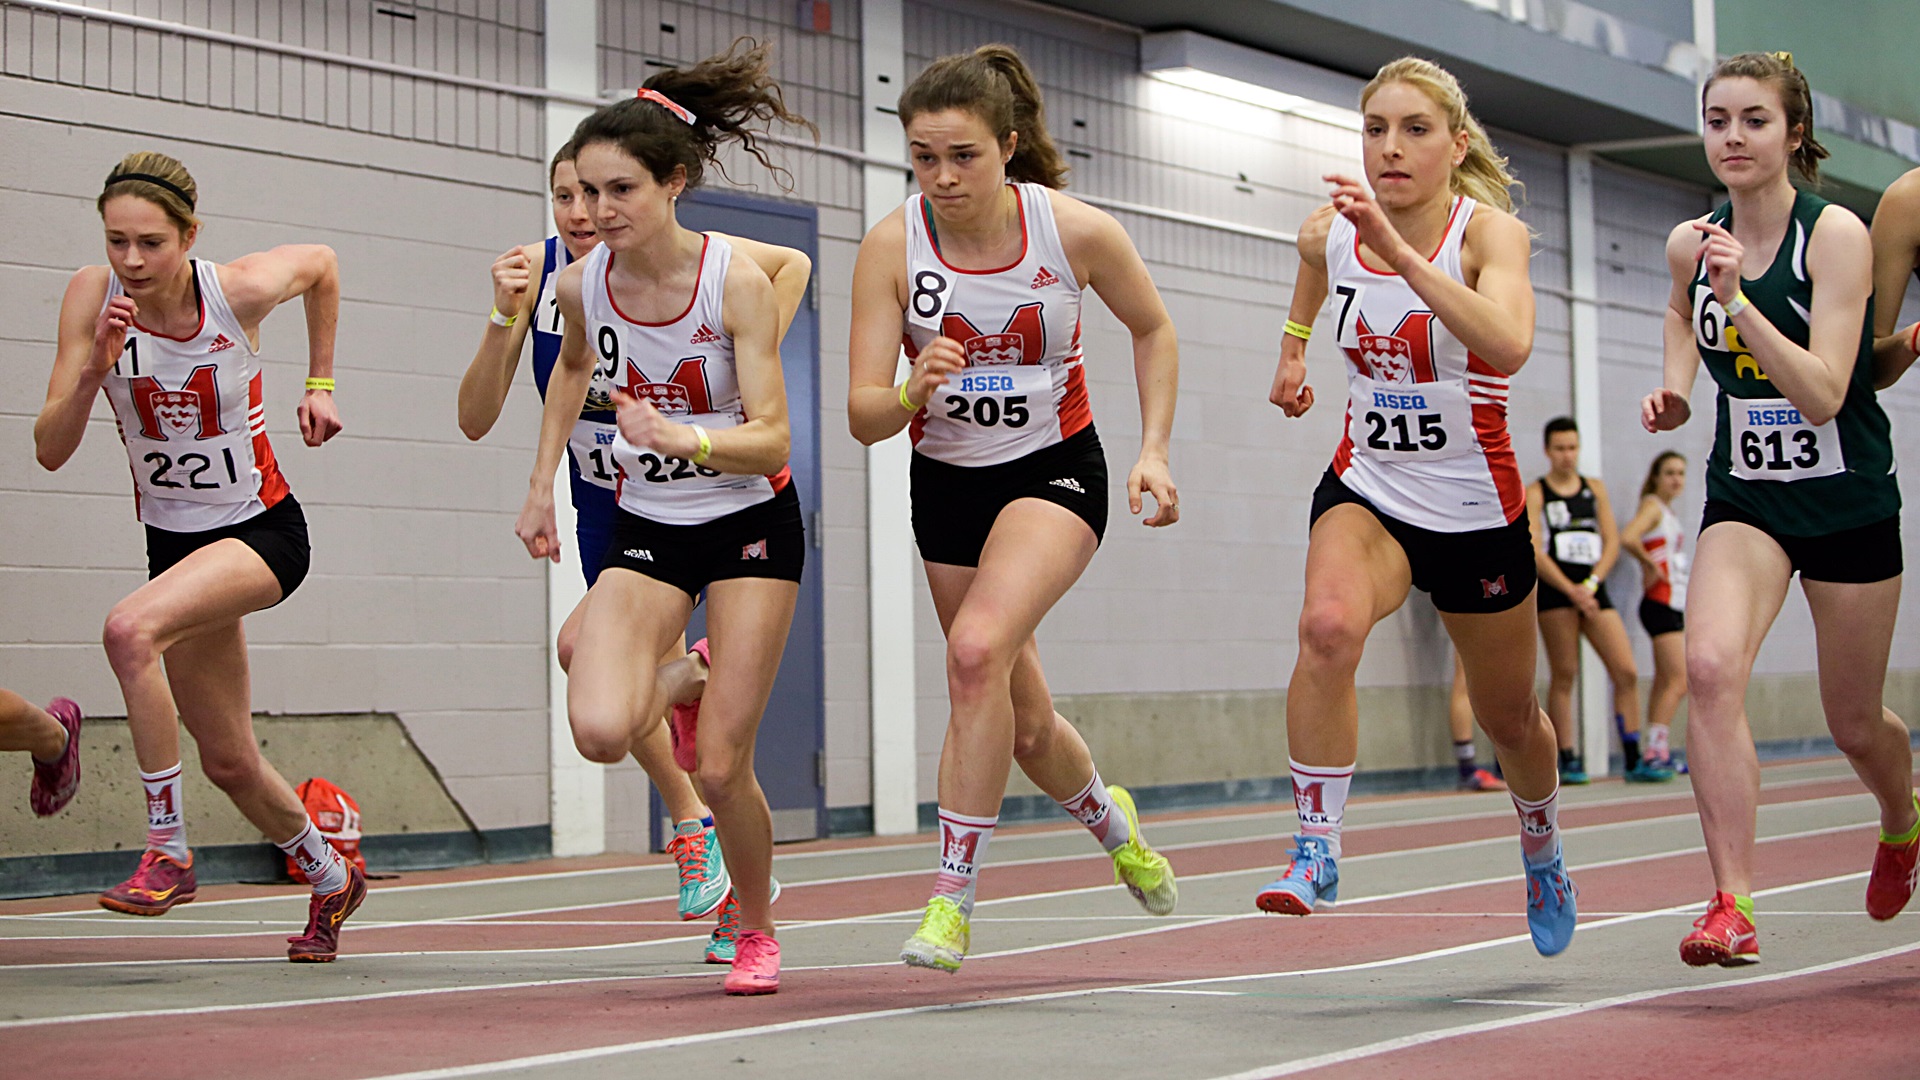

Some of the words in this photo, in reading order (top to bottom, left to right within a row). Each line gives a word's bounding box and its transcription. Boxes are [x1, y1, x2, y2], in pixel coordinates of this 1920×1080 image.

[912, 270, 947, 319] 8
[1031, 277, 1059, 290] adidas
[1336, 285, 1357, 342] 7
[1700, 292, 1718, 347] 6
[208, 341, 235, 353] adidas
[598, 325, 619, 379] 9
[690, 335, 721, 344] adidas
[960, 375, 1015, 391] RSEQ
[944, 395, 1030, 429] 205
[1373, 392, 1428, 409] RSEQ
[1747, 410, 1803, 425] RSEQ
[1364, 411, 1447, 452] 215
[1740, 430, 1820, 471] 613
[143, 447, 238, 490] 221
[941, 859, 974, 875] RACK
